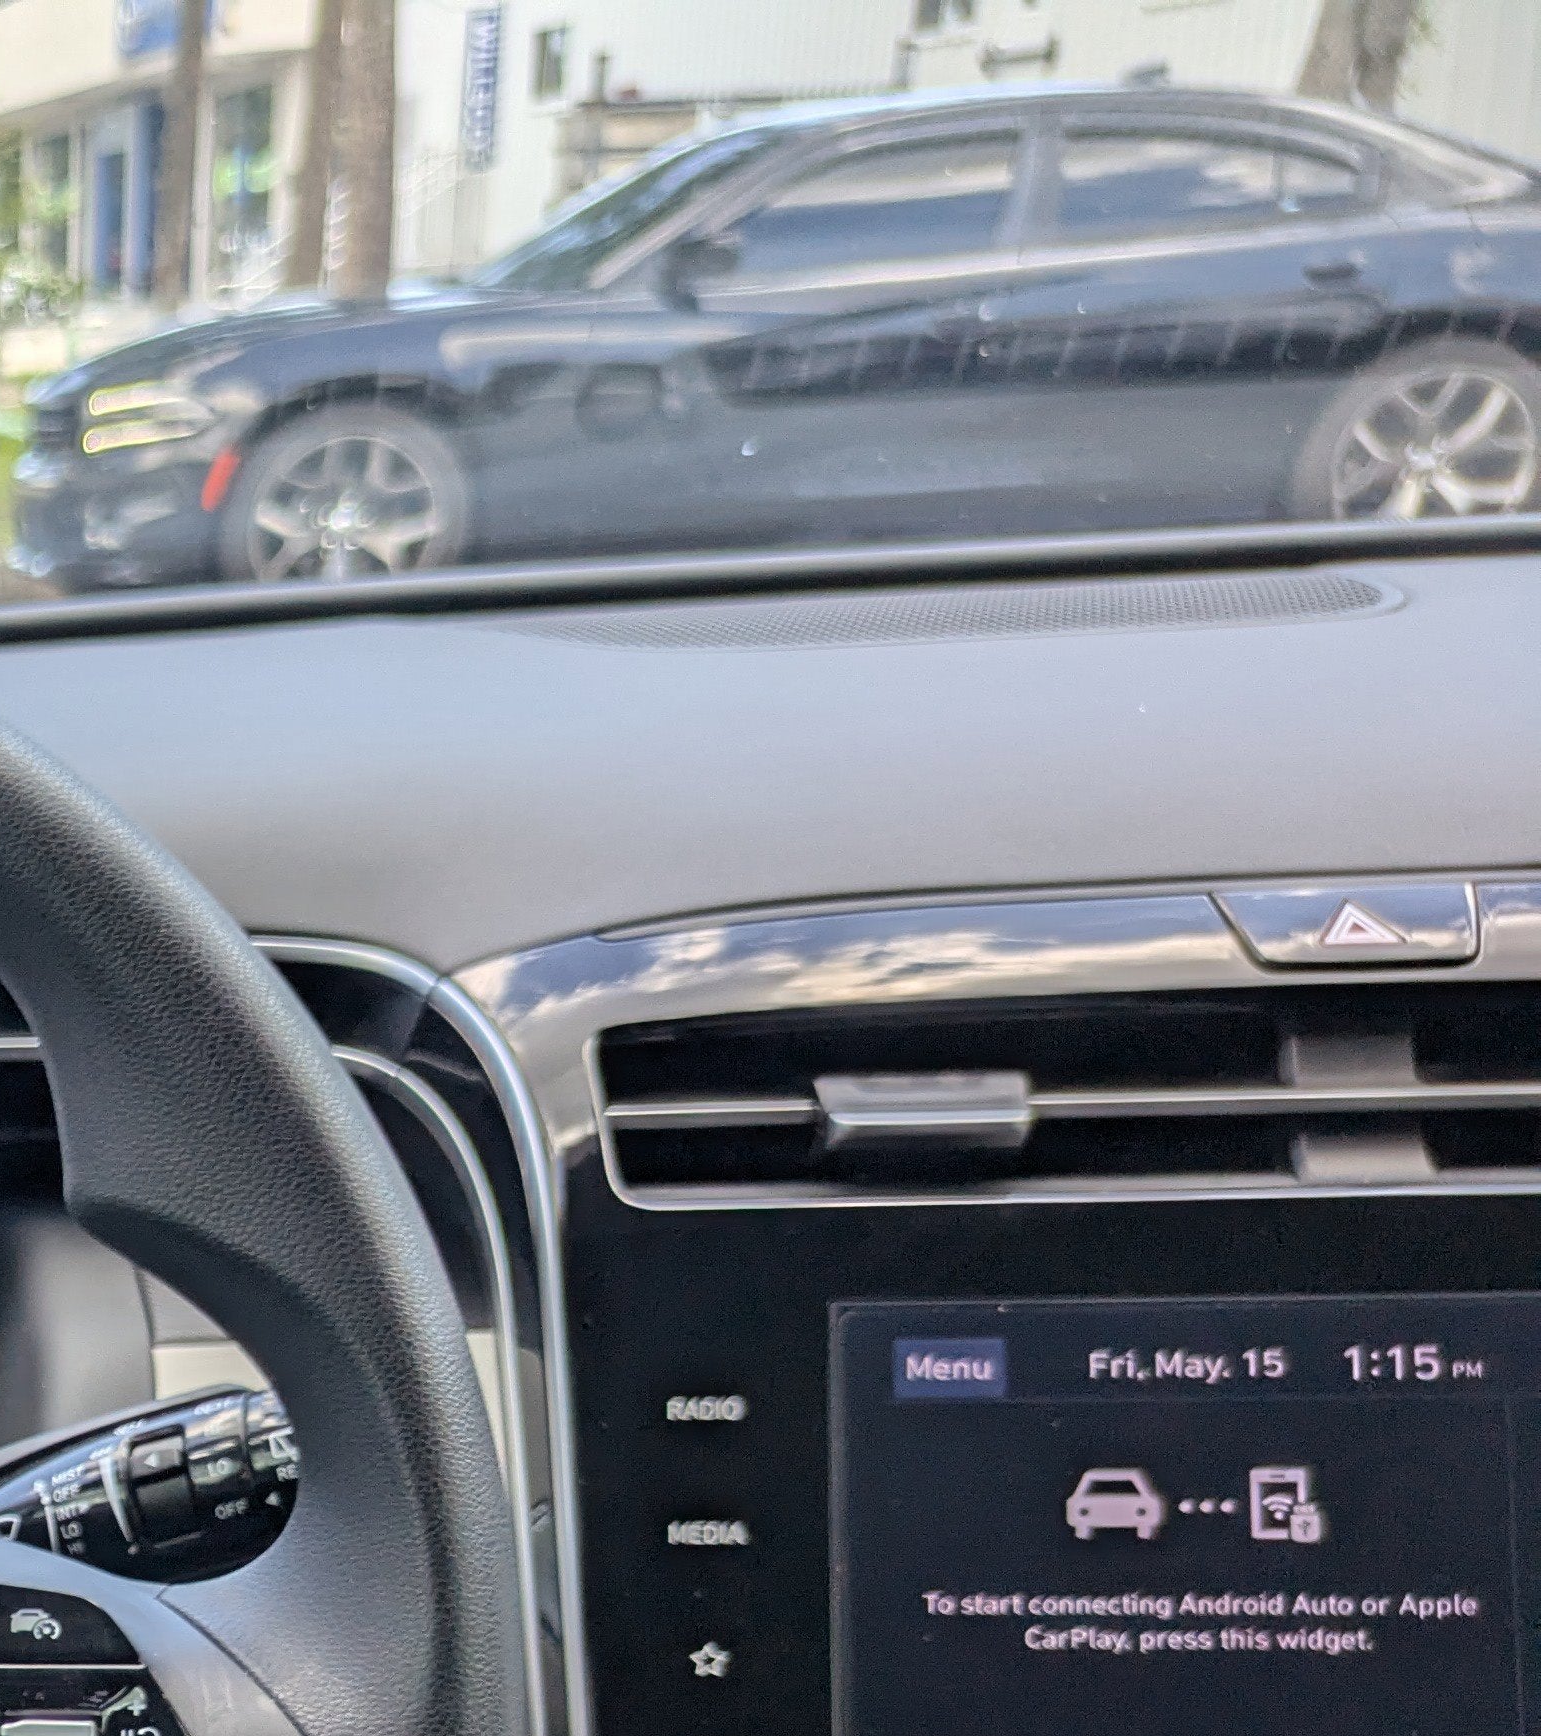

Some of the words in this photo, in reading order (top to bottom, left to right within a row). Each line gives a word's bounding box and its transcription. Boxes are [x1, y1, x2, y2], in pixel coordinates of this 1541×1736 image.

[905, 1353, 994, 1382] Menu
[1154, 1348, 1231, 1385] May.
[1242, 1347, 1287, 1379] 15
[1343, 1344, 1441, 1381] 1:15
[1452, 1360, 1484, 1378] PM
[666, 1395, 747, 1422] RADIO
[667, 1519, 751, 1547] MEDIA
[921, 1590, 957, 1616] To
[960, 1592, 1024, 1616] start
[1027, 1590, 1172, 1620] connecting
[1179, 1592, 1285, 1616] Android
[1292, 1592, 1355, 1616] Auto
[1360, 1597, 1390, 1616] or
[1399, 1593, 1479, 1619] Apple
[1138, 1629, 1216, 1653] press
[1220, 1627, 1269, 1651] this
[1275, 1627, 1376, 1655] widget.
